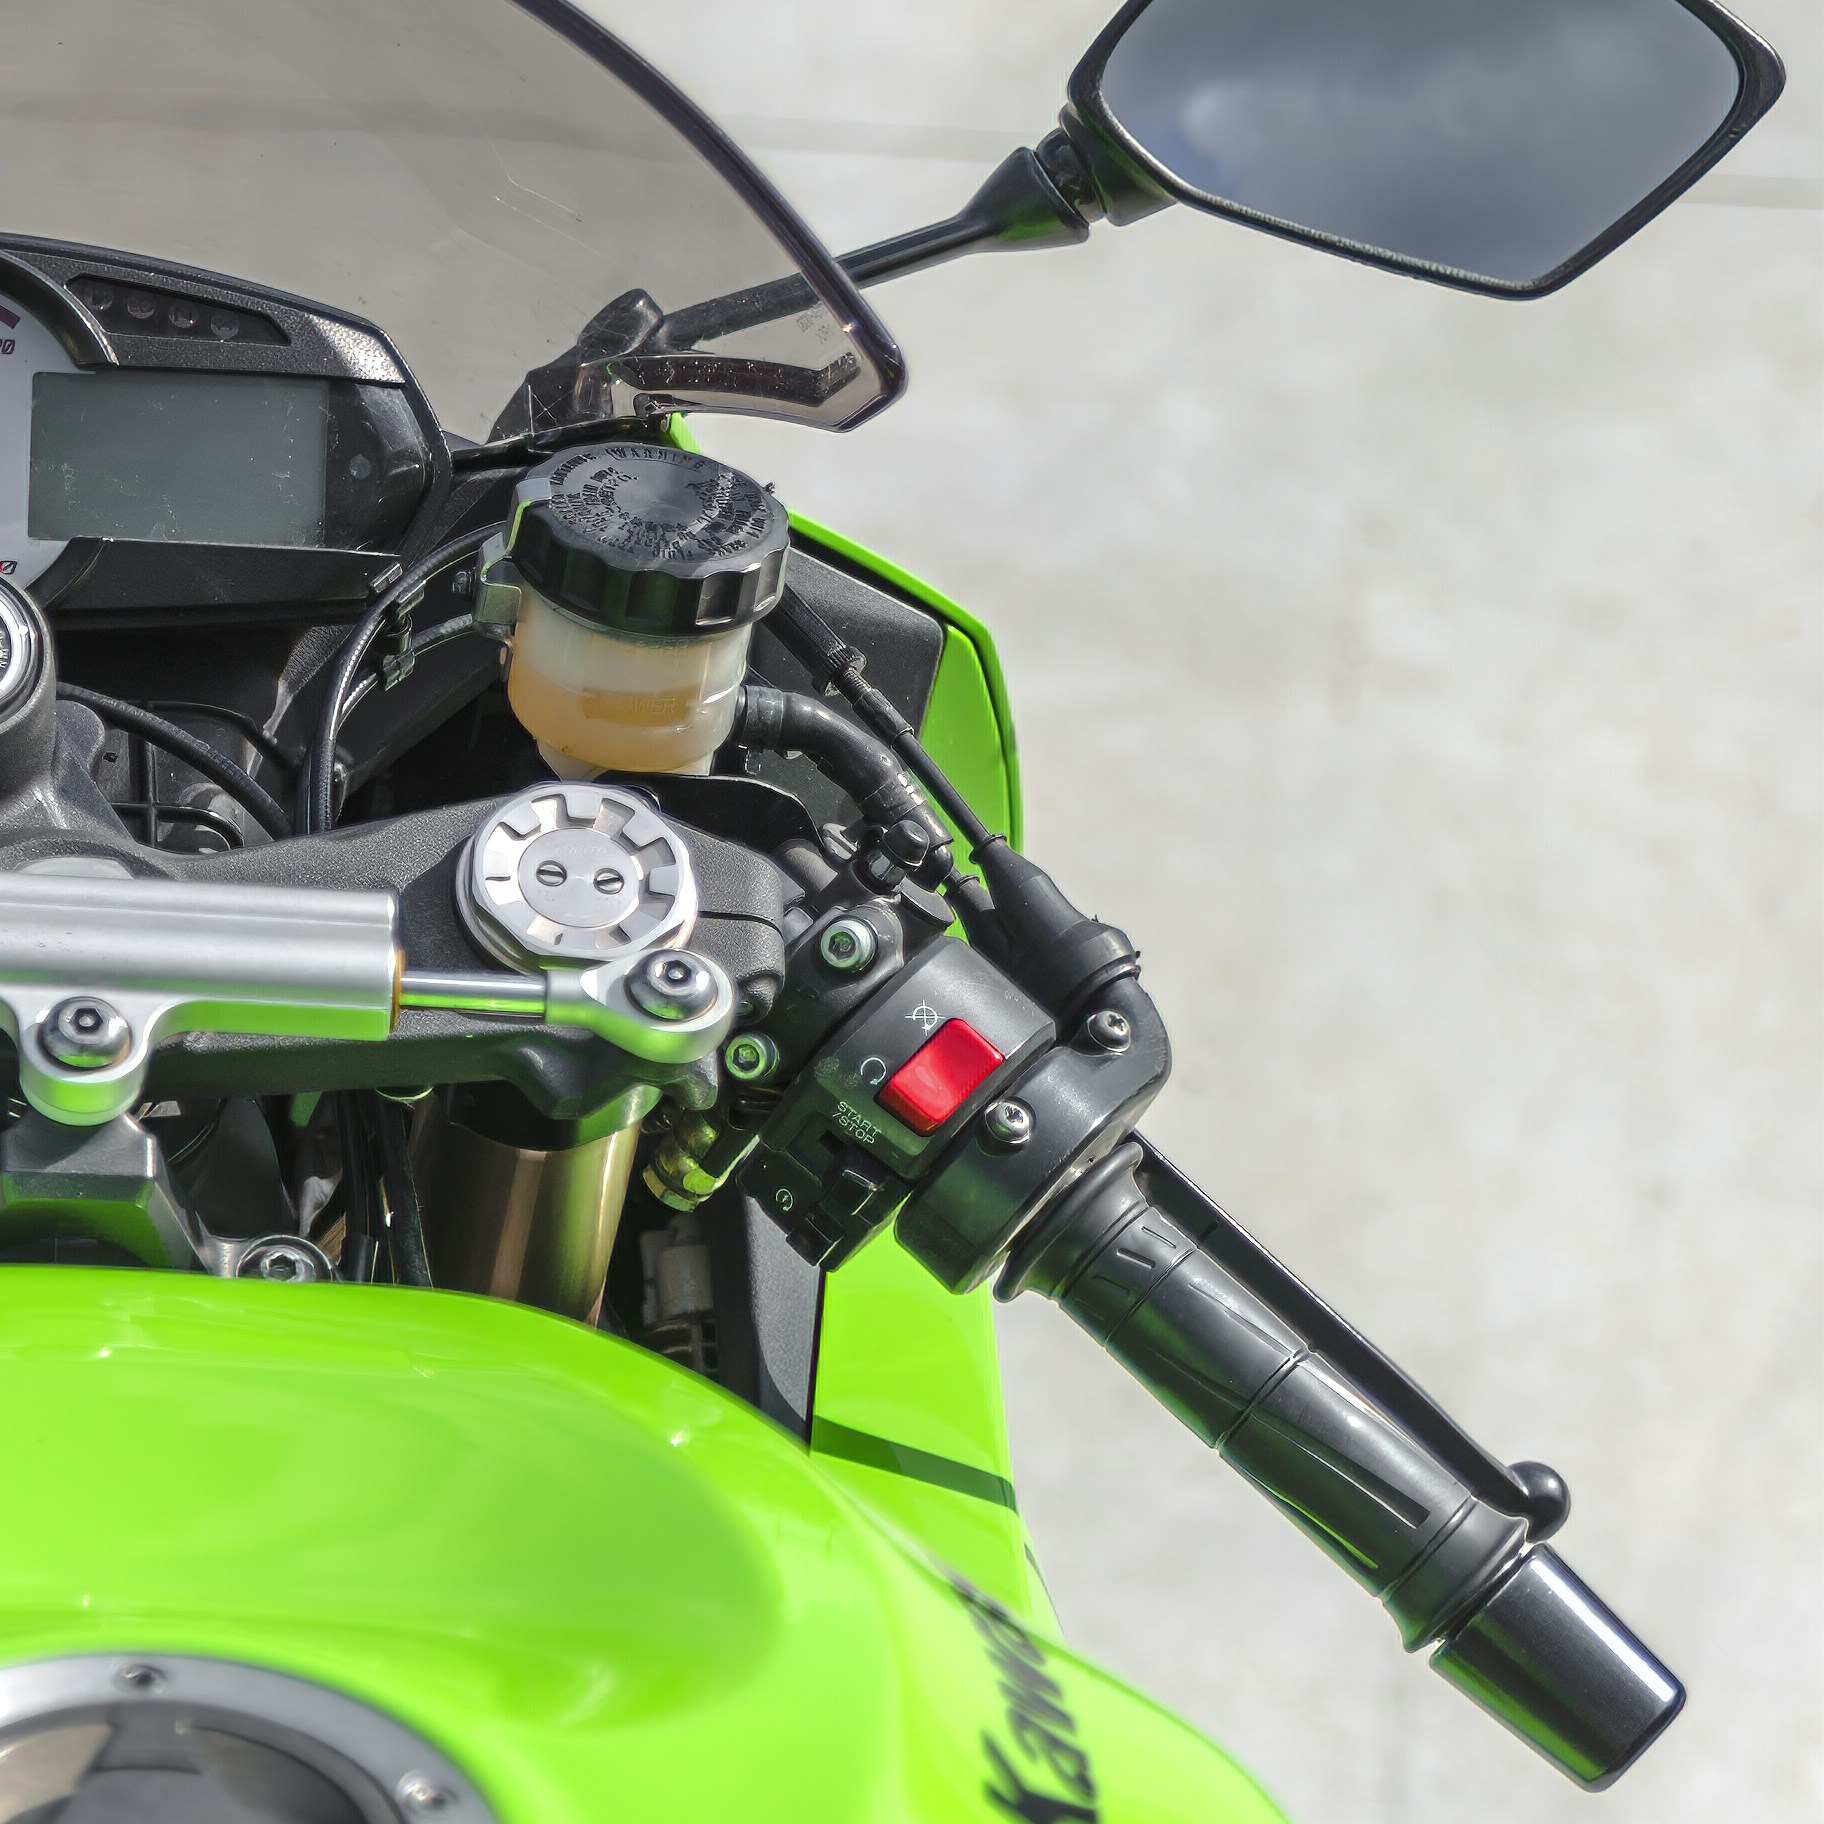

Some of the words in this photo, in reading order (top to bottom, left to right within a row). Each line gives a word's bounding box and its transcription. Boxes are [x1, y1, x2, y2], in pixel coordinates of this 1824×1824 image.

[0, 560, 18, 575] 0
[832, 1111, 875, 1145] /STOP
[837, 1100, 882, 1138] START
